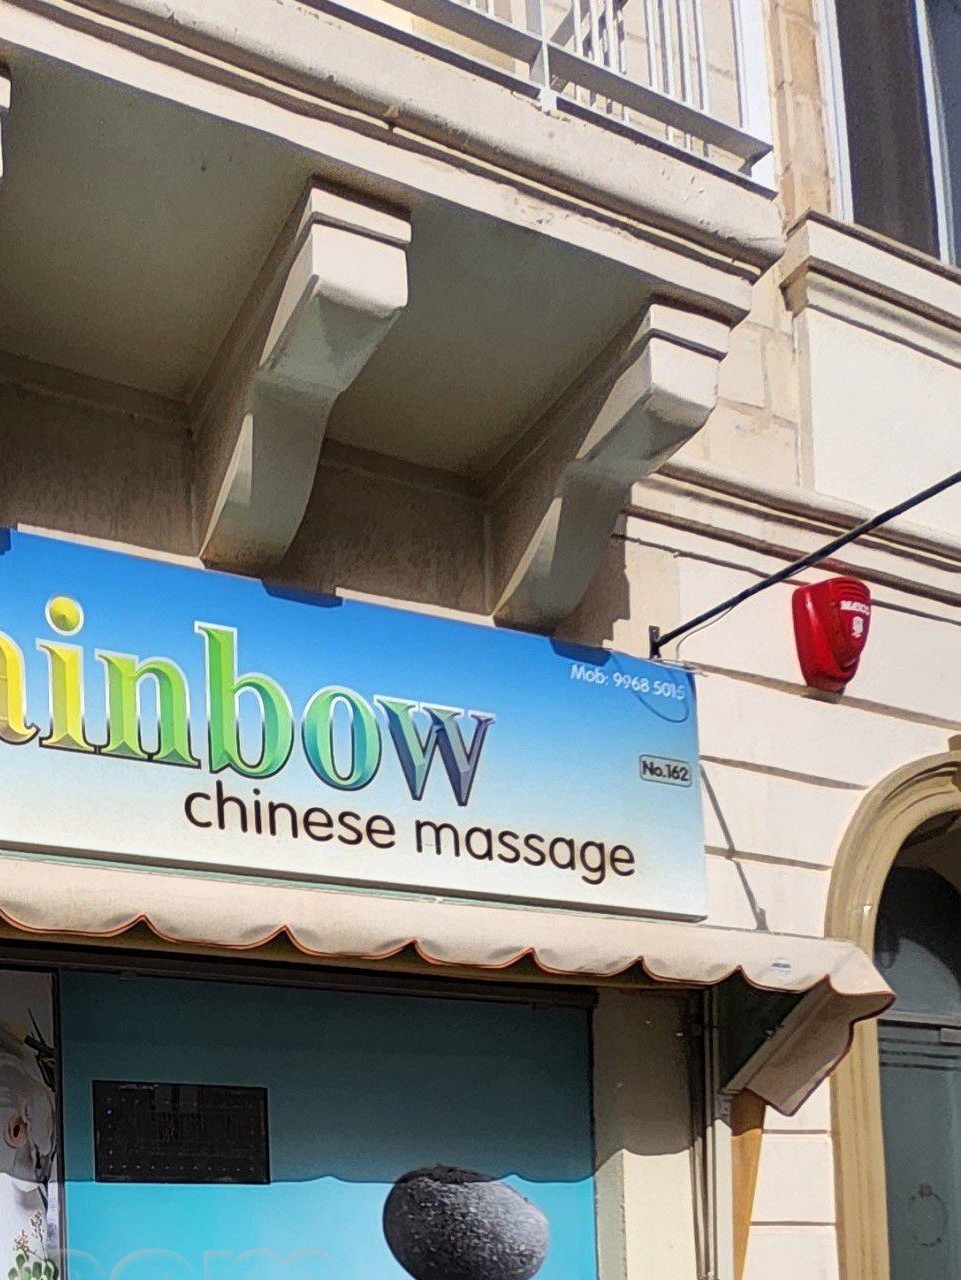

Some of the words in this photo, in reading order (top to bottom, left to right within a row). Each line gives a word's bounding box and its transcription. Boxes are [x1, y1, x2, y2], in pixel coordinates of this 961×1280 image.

[570, 664, 609, 686] Mob:
[612, 672, 650, 693] 9968
[642, 760, 689, 782] No.162
[183, 779, 397, 848] chinese
[415, 816, 636, 885] massage
